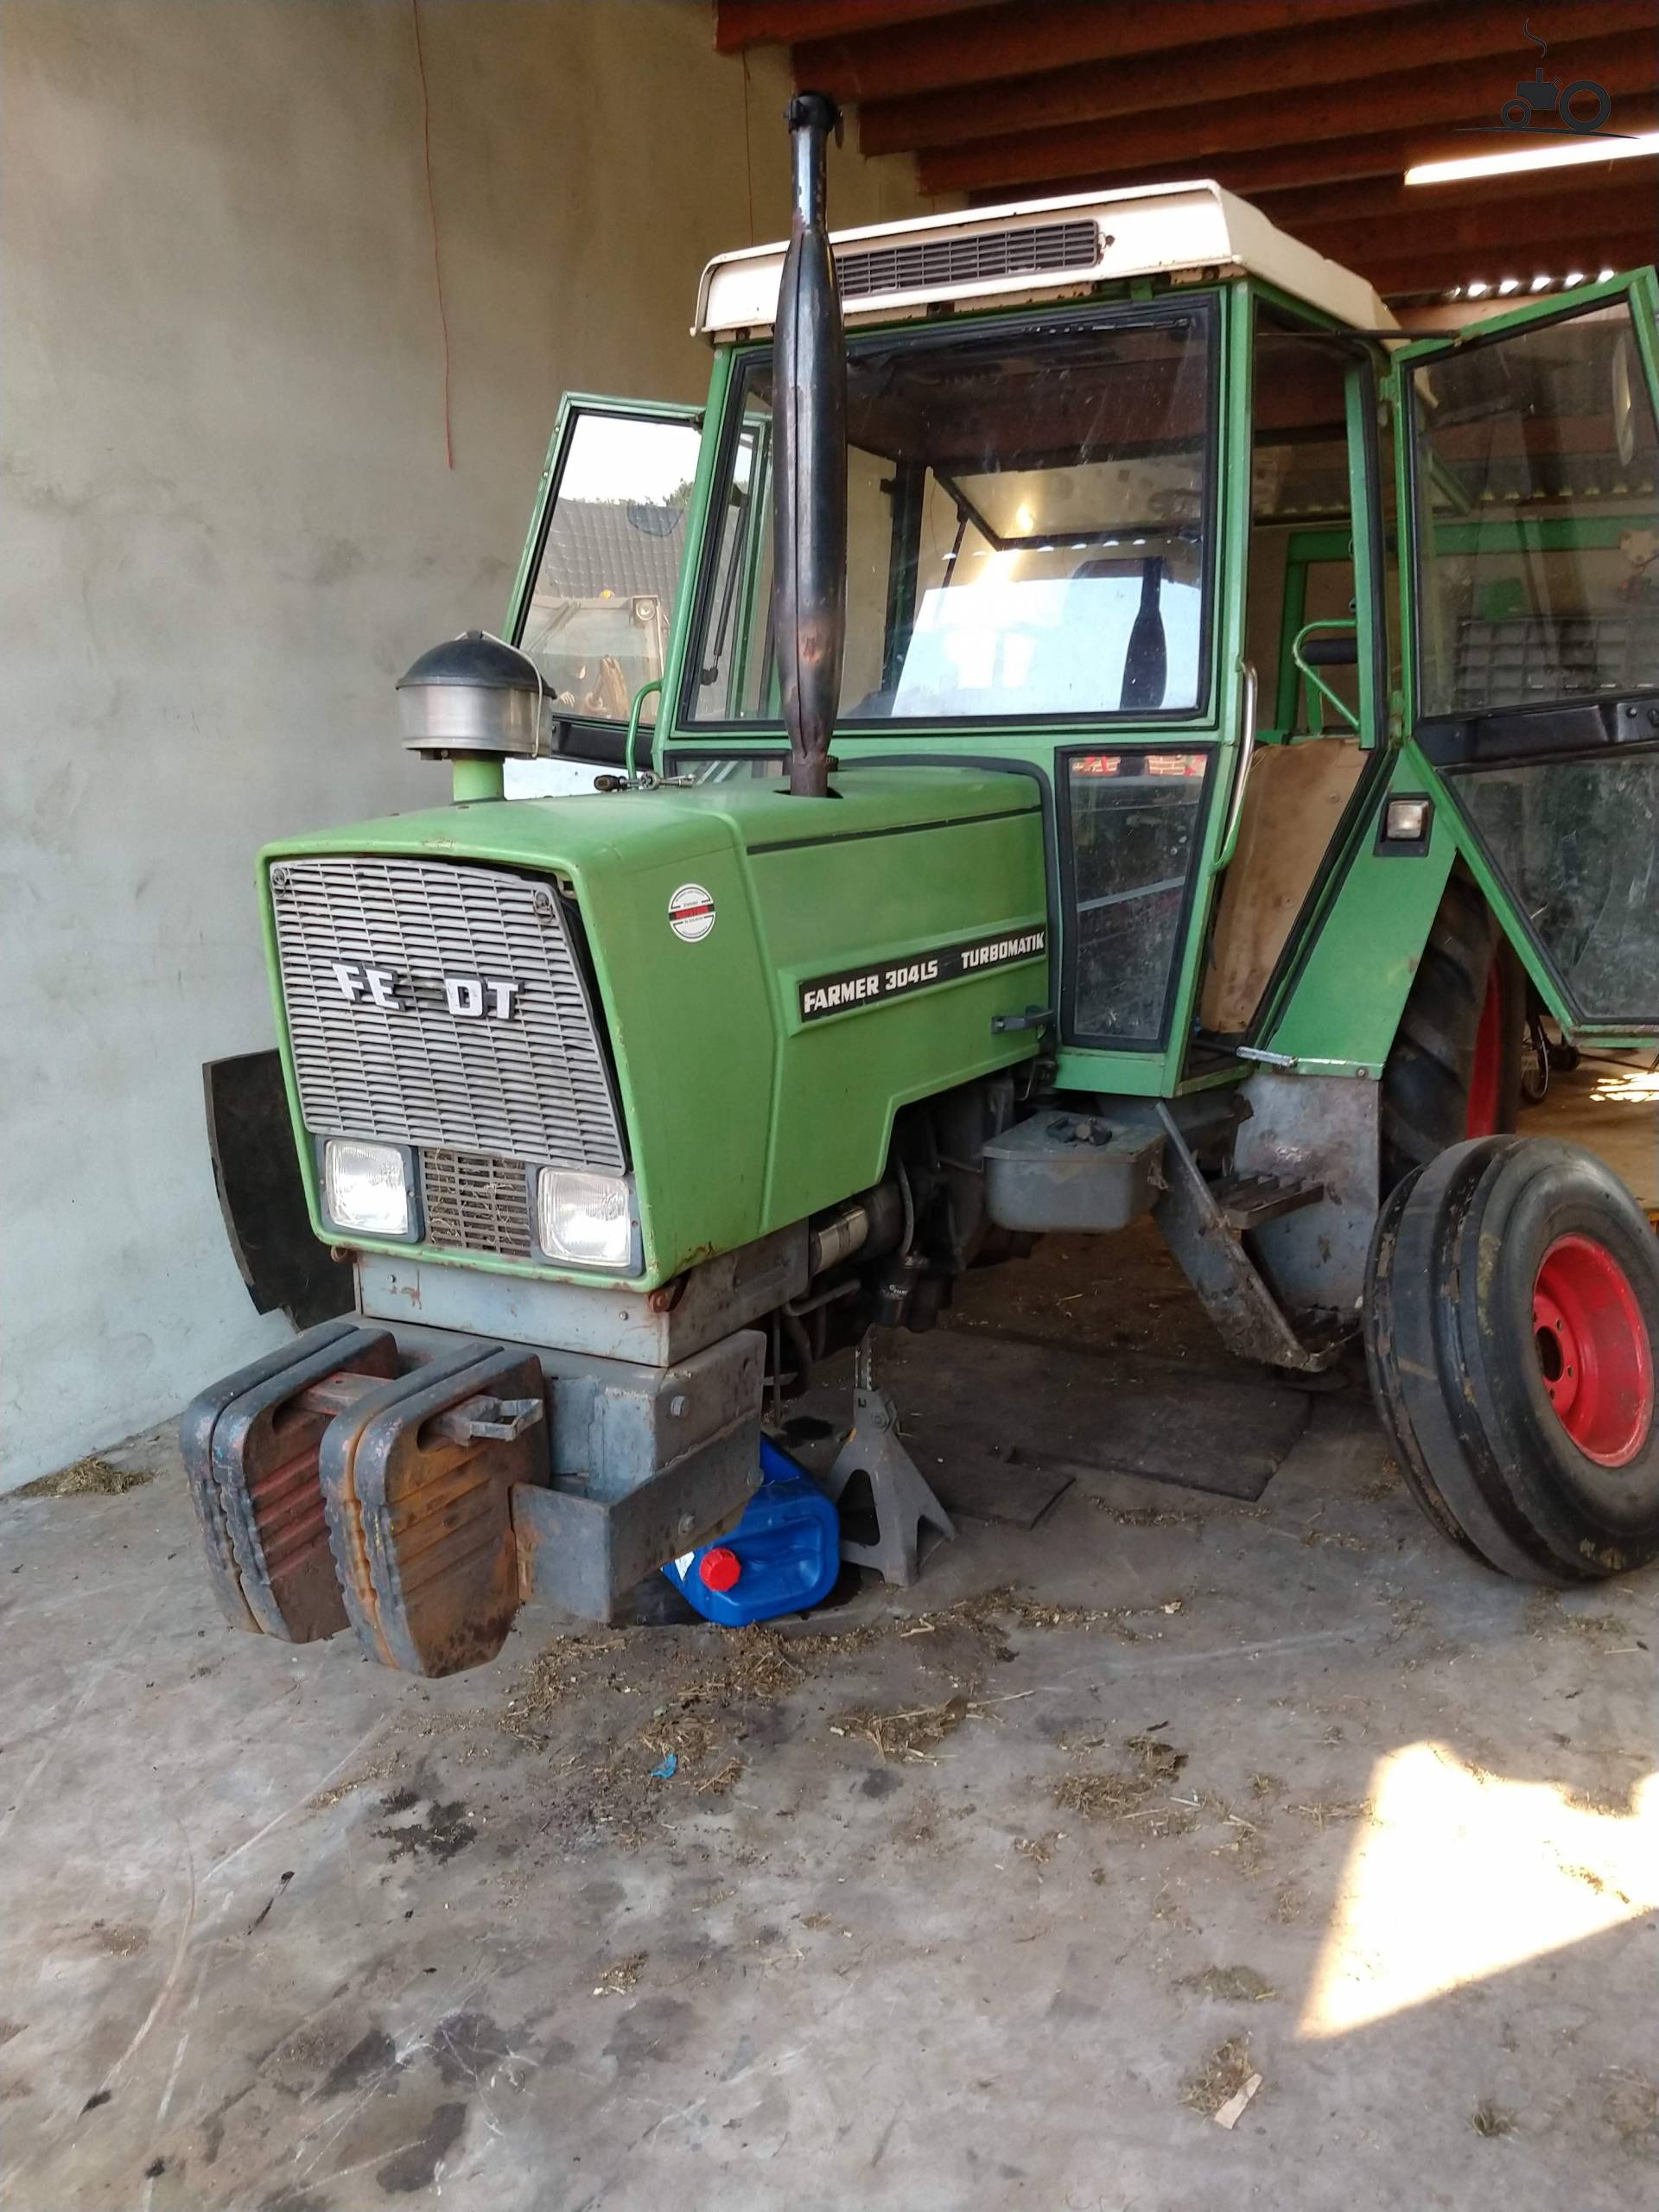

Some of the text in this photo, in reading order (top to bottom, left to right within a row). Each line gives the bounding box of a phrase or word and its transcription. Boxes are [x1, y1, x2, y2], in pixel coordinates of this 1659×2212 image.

[804, 931, 1045, 1014] FARMER 304LS TURBOMATIK
